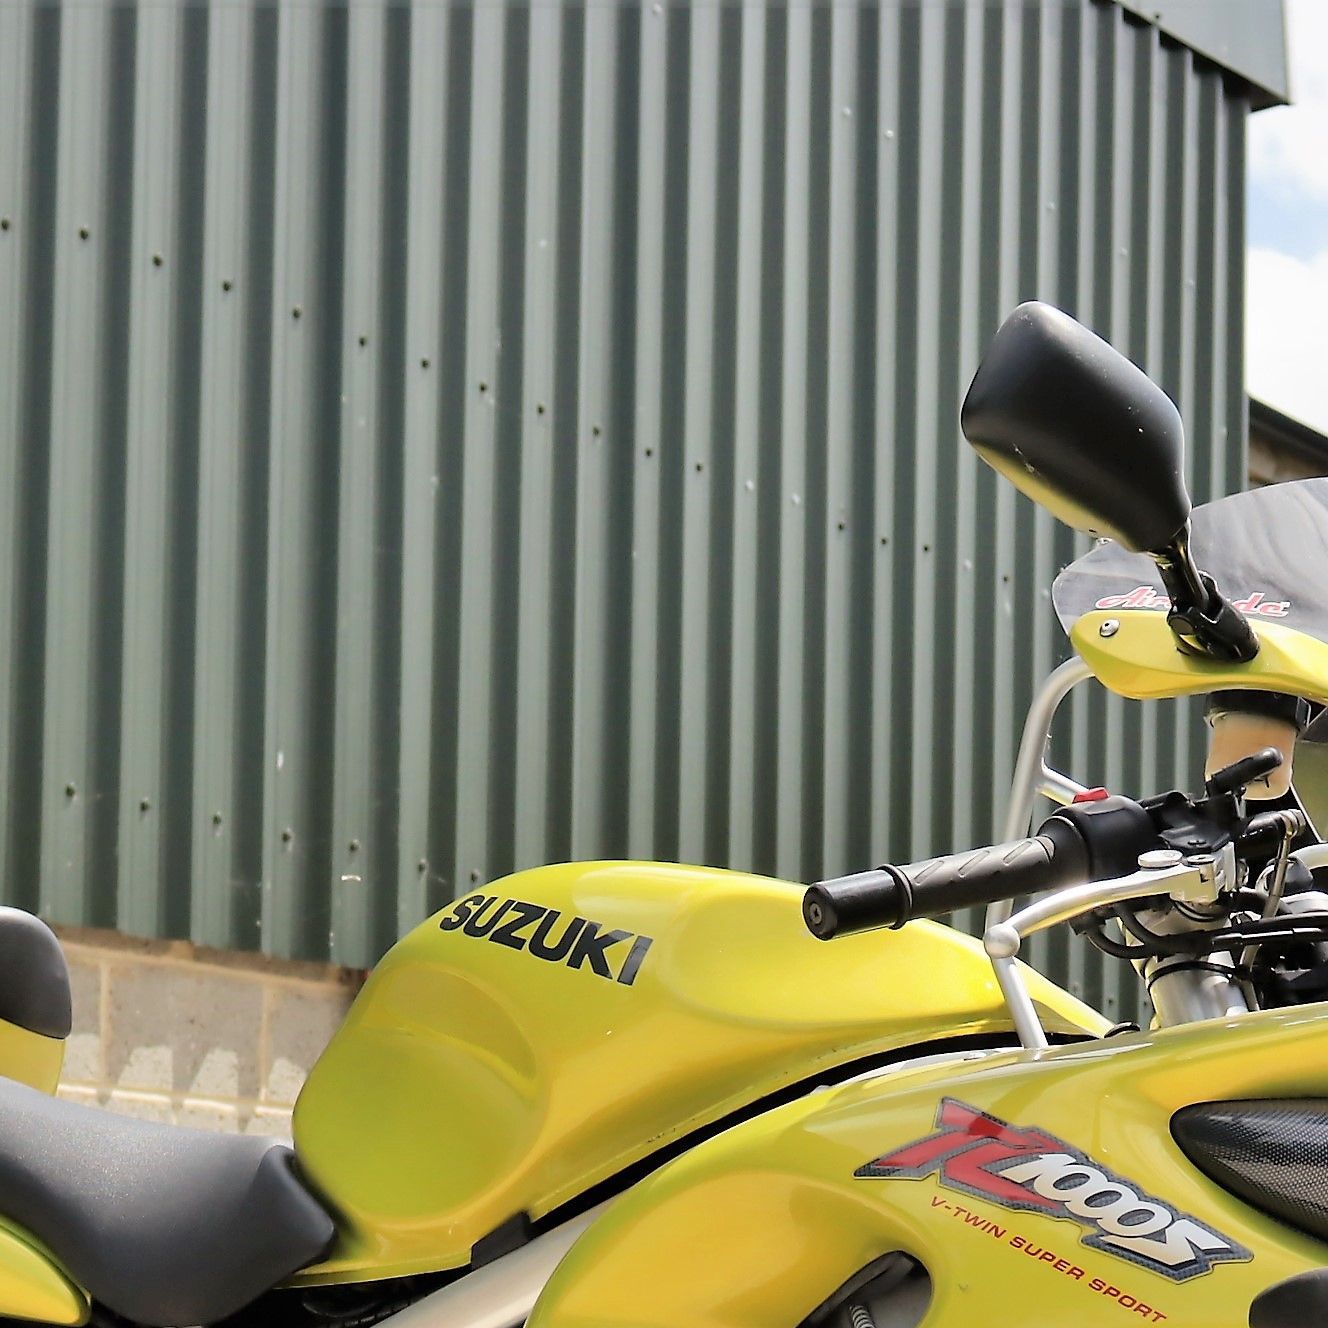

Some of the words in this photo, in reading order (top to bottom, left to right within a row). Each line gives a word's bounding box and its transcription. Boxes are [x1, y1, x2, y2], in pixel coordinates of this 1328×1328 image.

[1095, 585, 1291, 617] Airde
[439, 895, 653, 986] SUZUKI
[930, 1195, 1007, 1240] V-TWIN
[1009, 1235, 1086, 1281] SUPER
[1088, 1277, 1168, 1324] SPORT
